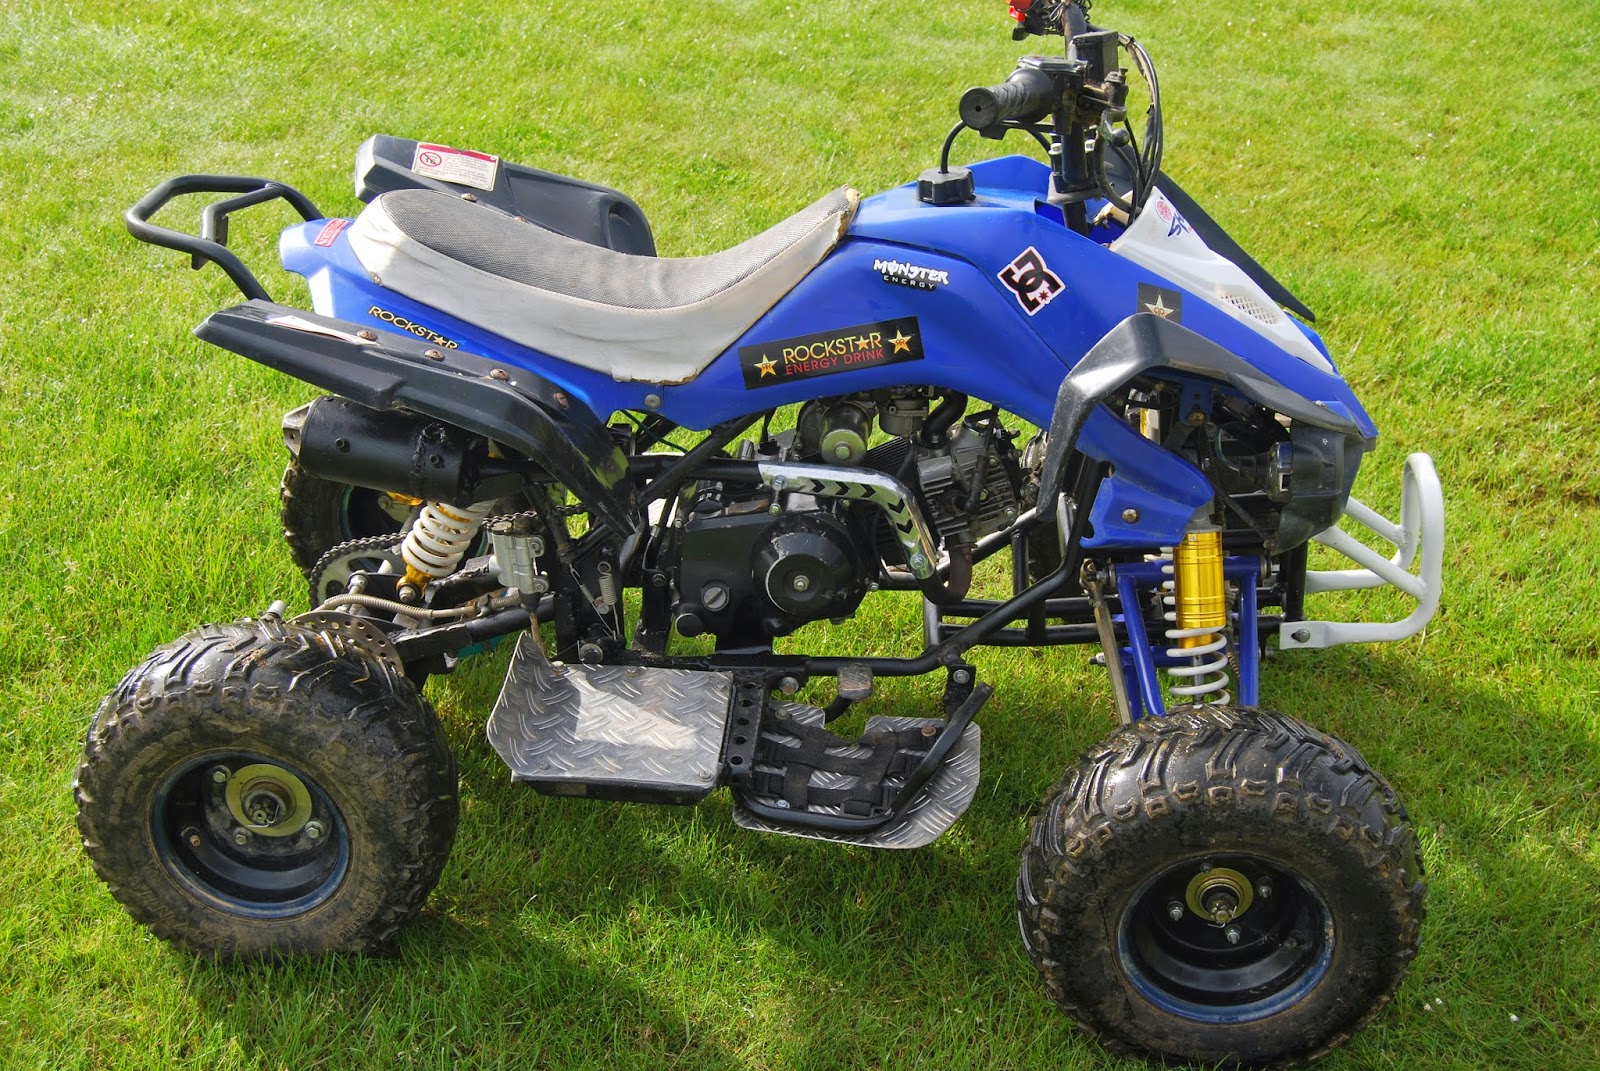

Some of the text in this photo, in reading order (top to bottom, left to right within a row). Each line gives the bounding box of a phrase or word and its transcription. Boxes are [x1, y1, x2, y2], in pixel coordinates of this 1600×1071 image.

[873, 259, 949, 285] MONSTER
[883, 274, 935, 290] ENERGY
[785, 348, 885, 375] ENERGY DRINK
